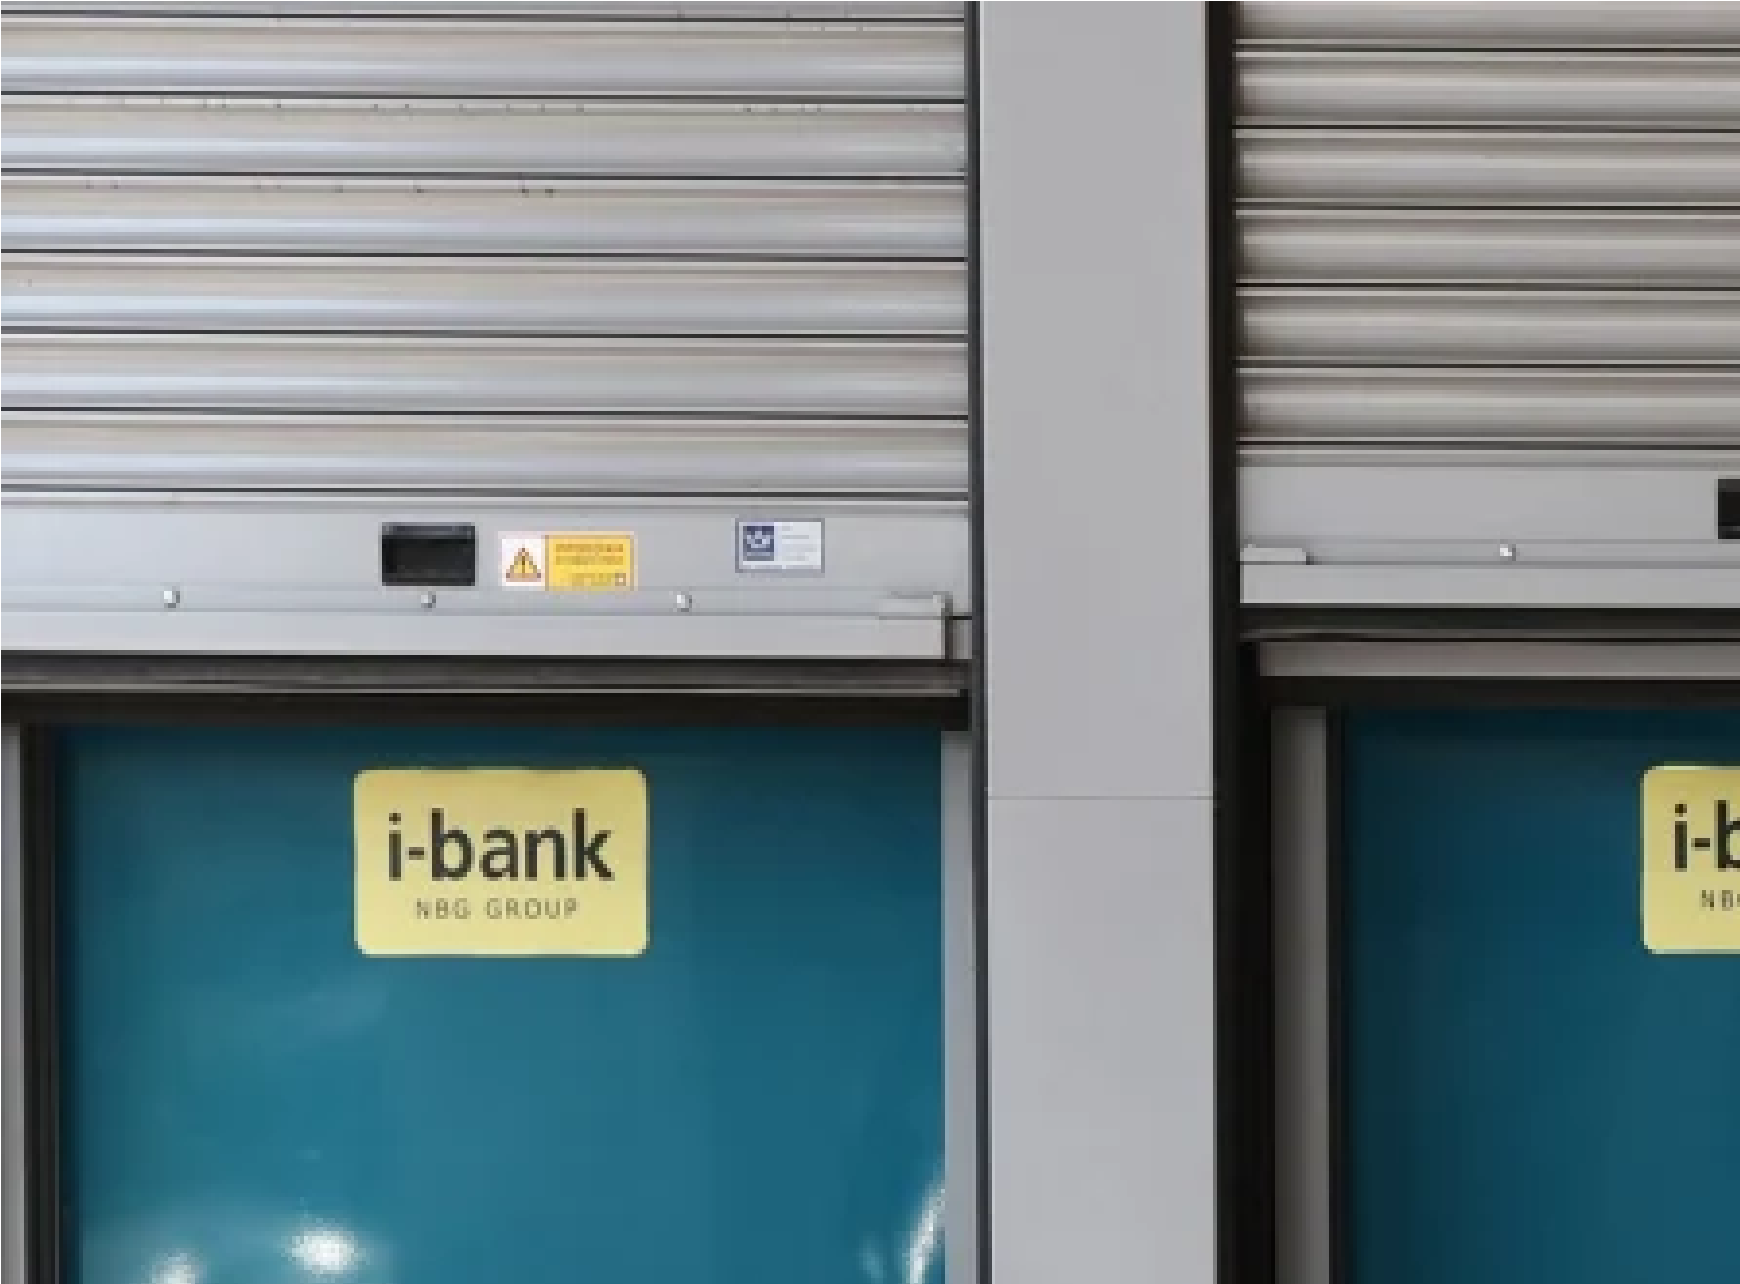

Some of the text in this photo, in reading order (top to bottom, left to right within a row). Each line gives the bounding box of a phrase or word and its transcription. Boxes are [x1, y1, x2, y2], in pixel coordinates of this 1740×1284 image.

[386, 807, 616, 882] i-bank
[414, 897, 578, 920] NBG GROUP
